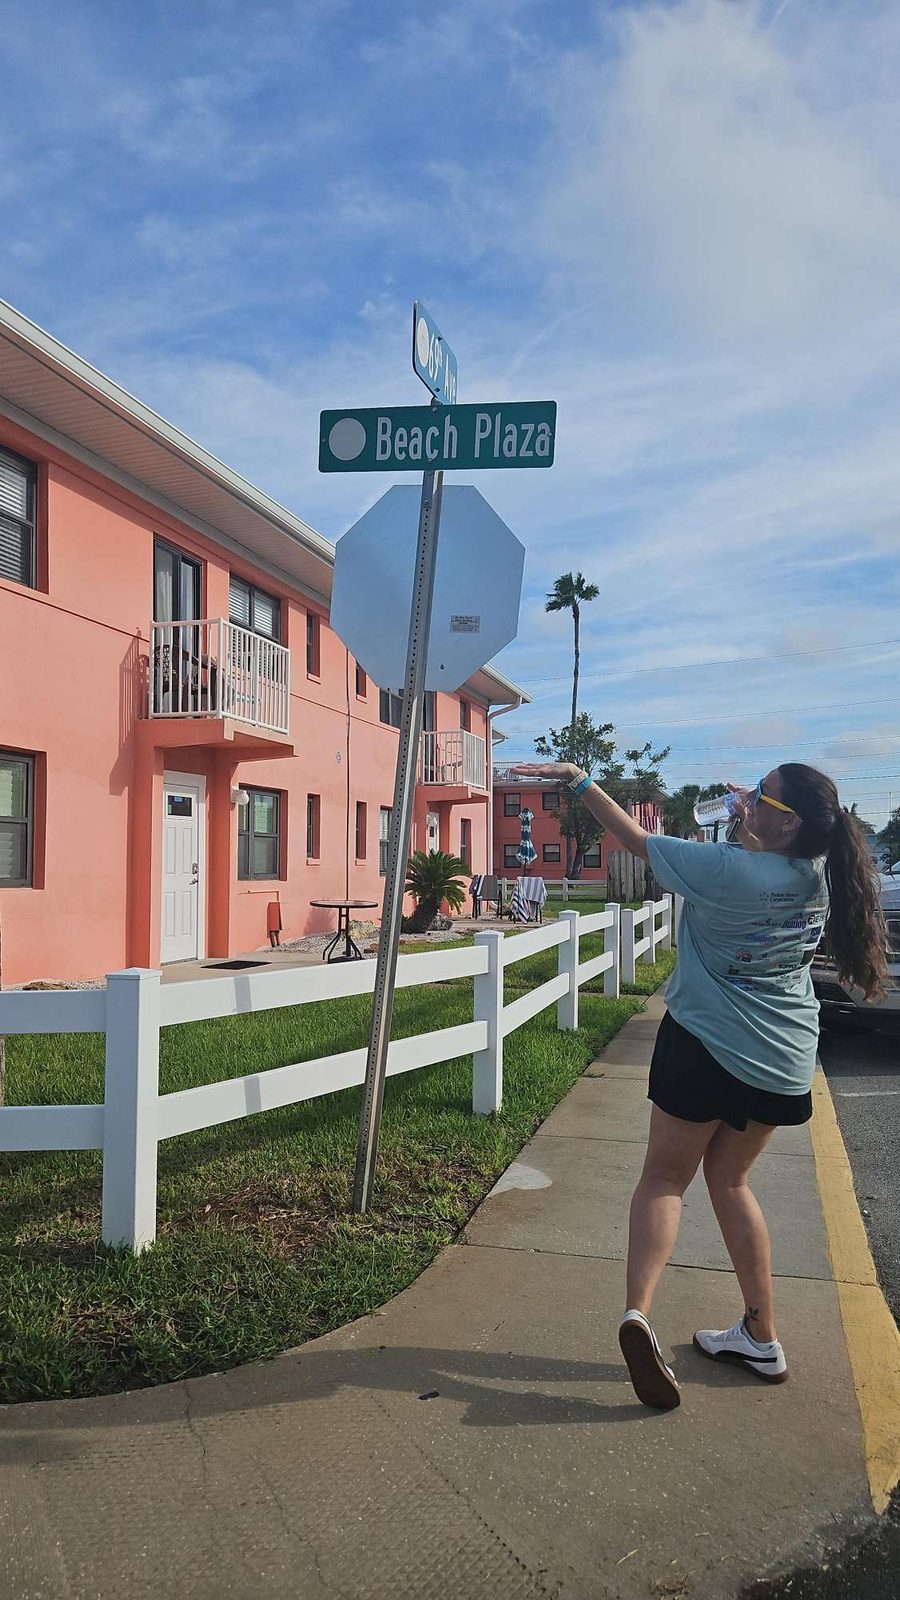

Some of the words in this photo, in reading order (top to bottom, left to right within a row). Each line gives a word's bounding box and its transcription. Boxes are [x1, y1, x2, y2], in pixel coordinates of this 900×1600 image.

[443, 353, 456, 404] Ave
[375, 413, 458, 461] Beach
[473, 411, 551, 458] Plaza
